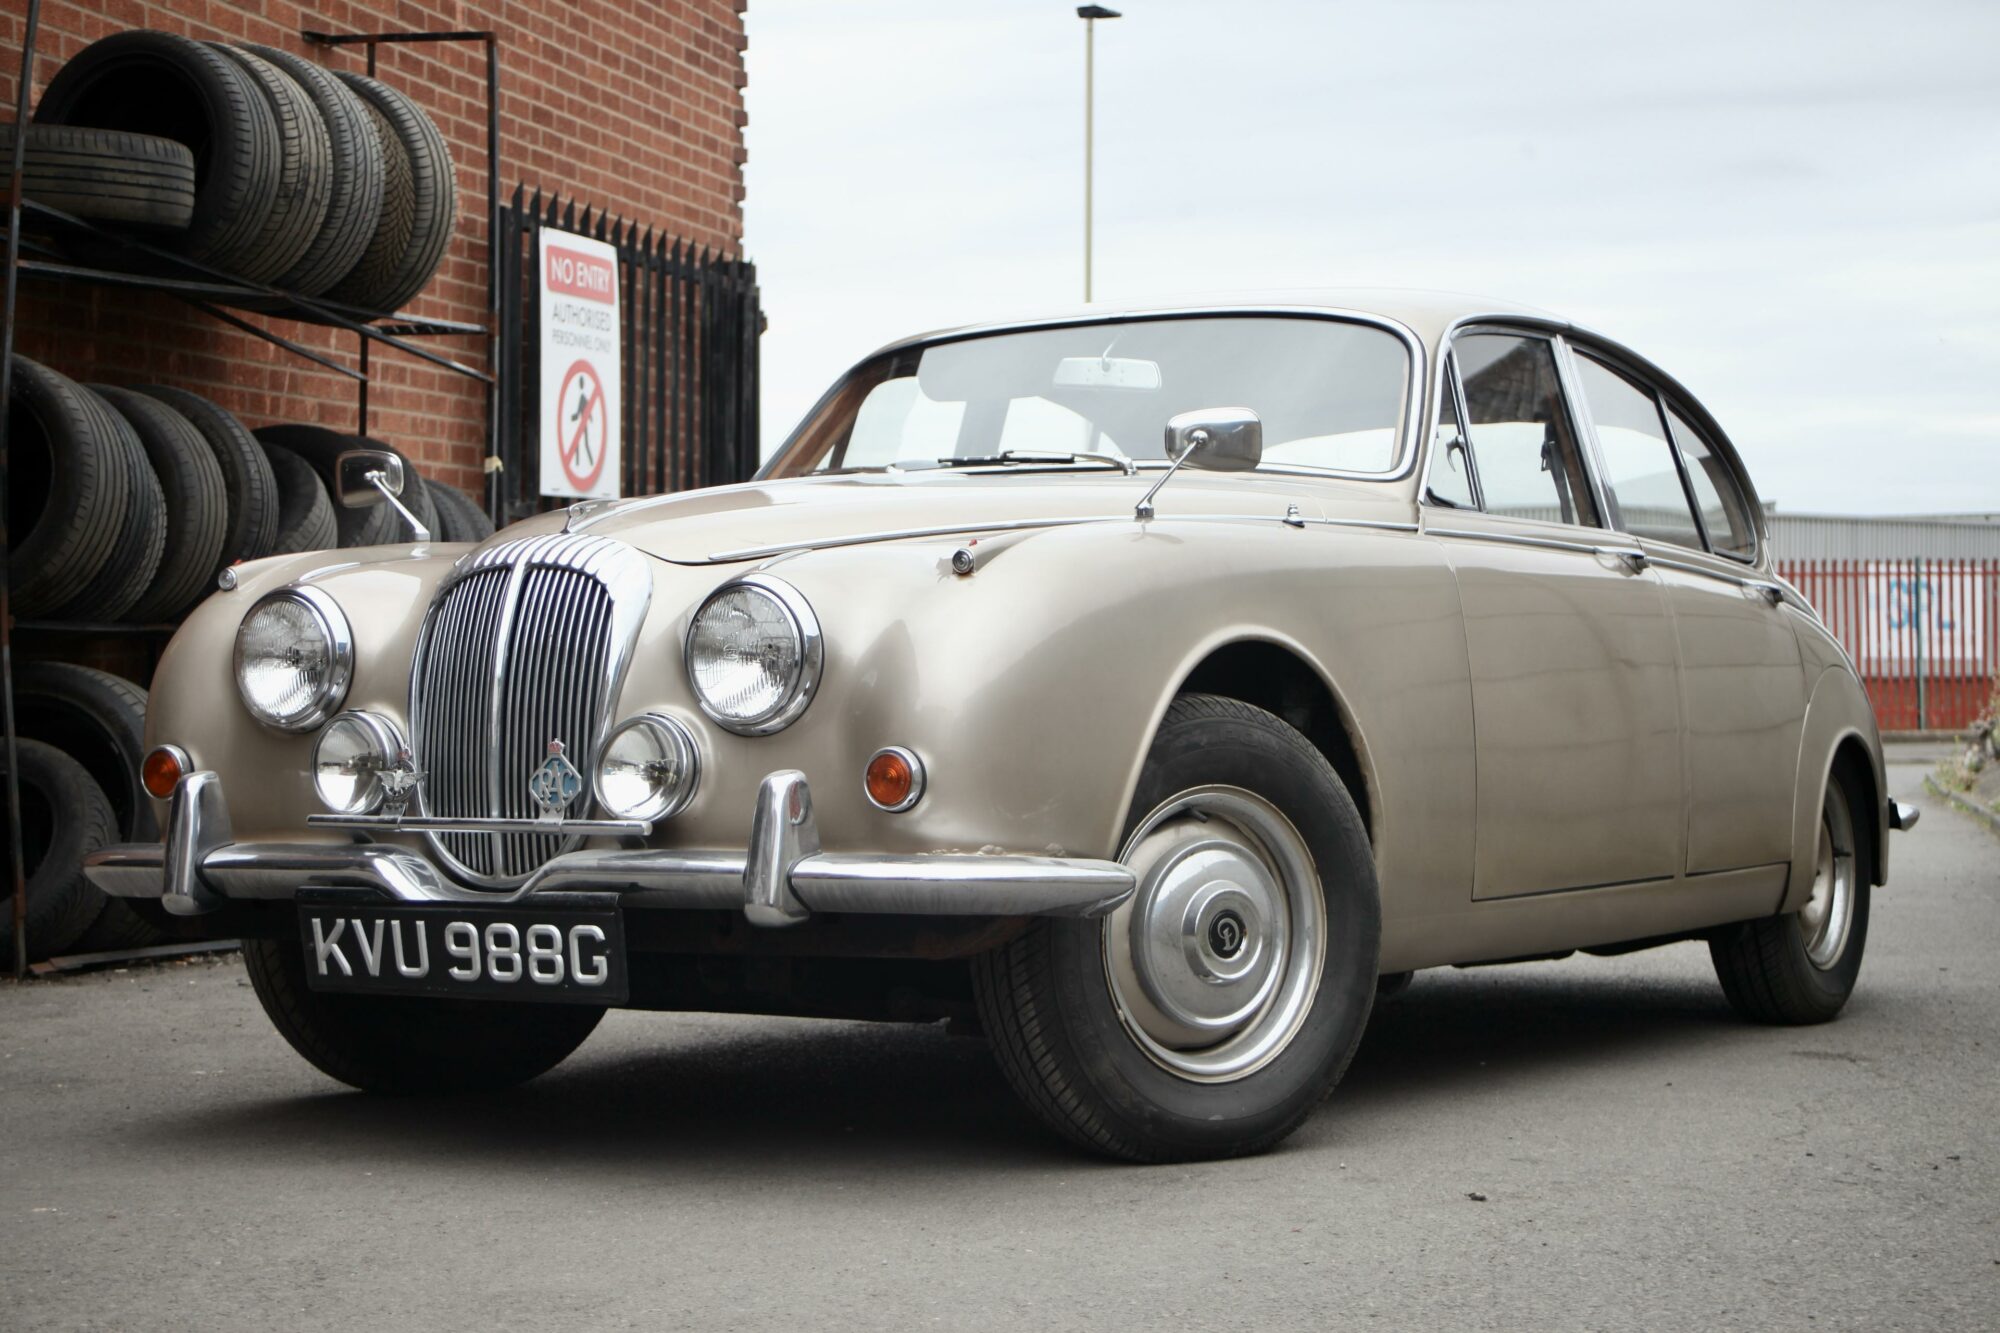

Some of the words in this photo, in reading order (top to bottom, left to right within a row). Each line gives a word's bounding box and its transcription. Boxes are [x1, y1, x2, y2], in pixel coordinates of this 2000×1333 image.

[551, 255, 574, 285] NO
[576, 261, 611, 293] ENTRY
[552, 302, 612, 332] AUTHORISED
[538, 760, 574, 806] RAC
[311, 918, 430, 979] KVU
[444, 921, 609, 986] 988G
